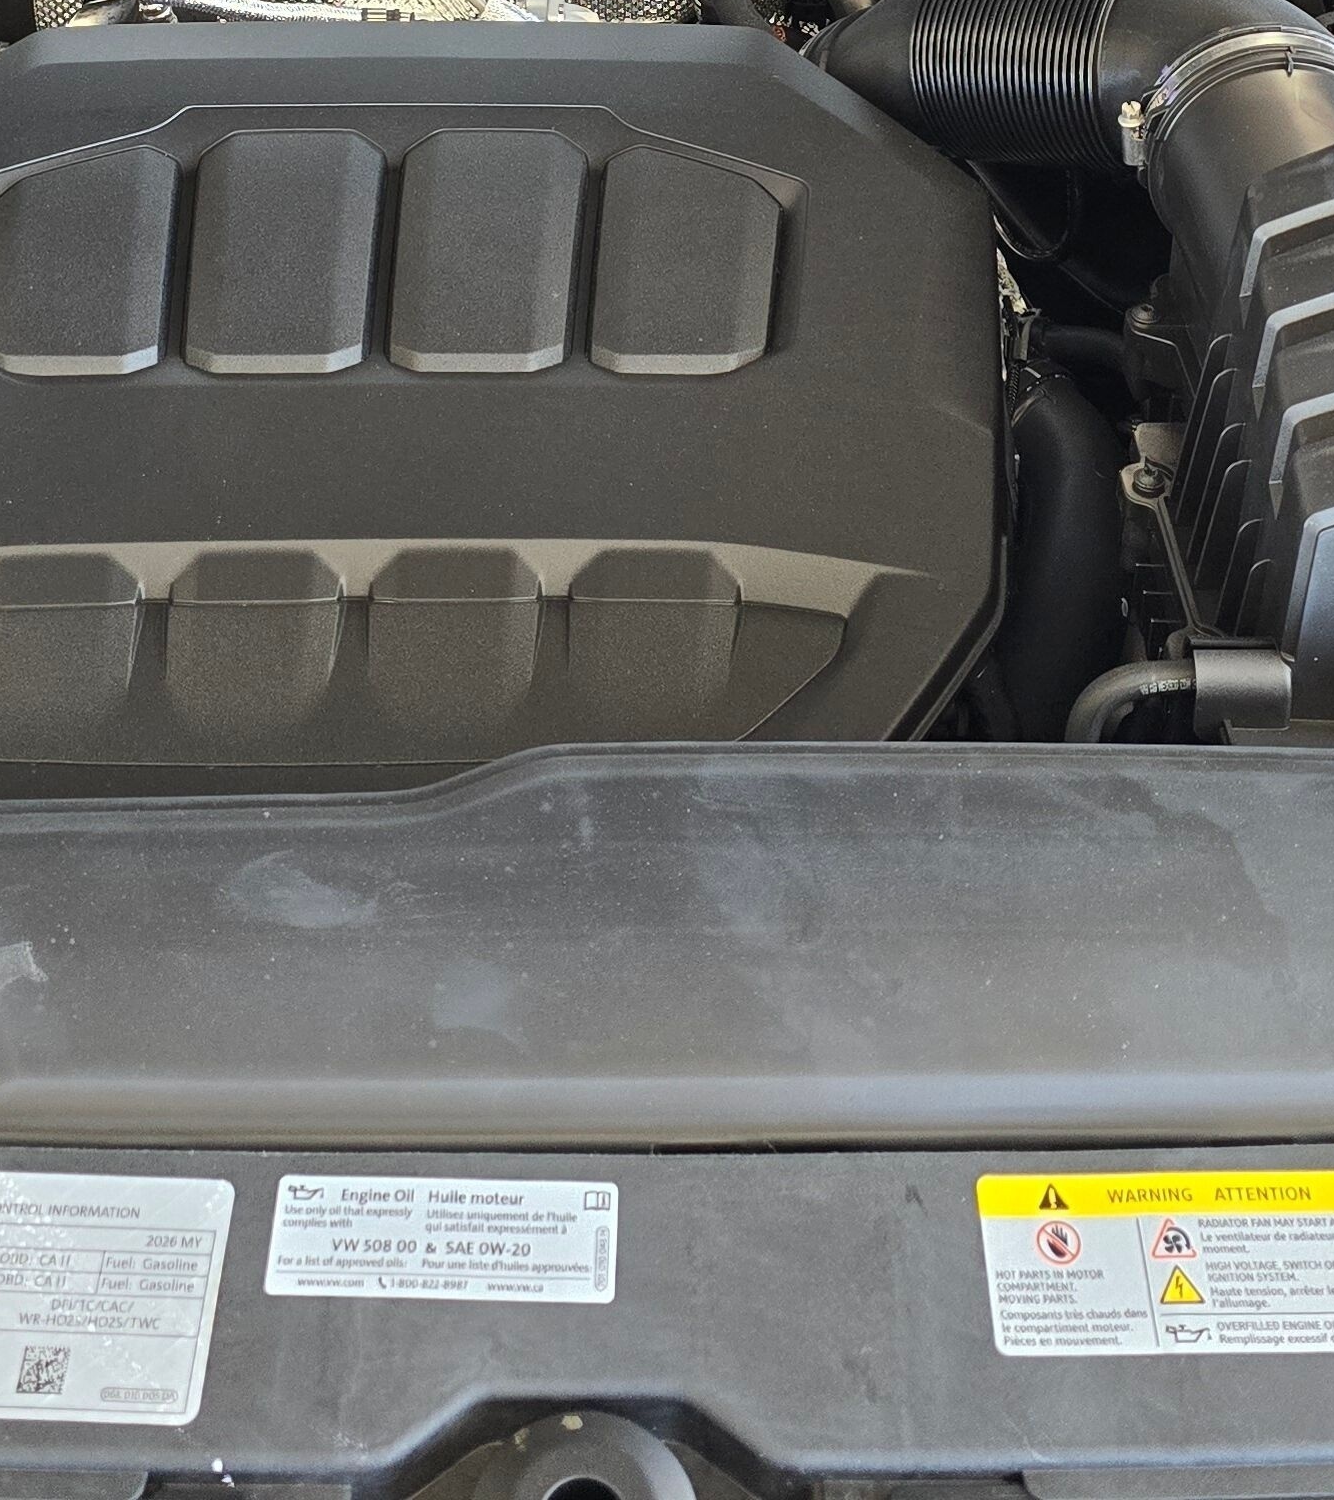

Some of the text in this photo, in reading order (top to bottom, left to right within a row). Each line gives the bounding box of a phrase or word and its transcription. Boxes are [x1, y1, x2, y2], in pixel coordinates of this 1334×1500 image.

[341, 1189, 414, 1205] Engine Oil
[428, 1190, 524, 1206] Huile moteur
[1107, 1186, 1311, 1204] WARNING ATTENTION
[48, 1204, 141, 1219] INFORMATION
[285, 1205, 413, 1219] Use only oil that expressly
[427, 1209, 578, 1222] Utilisez uniquement de l'huile
[282, 1218, 353, 1229] complies with
[425, 1222, 442, 1233] qui
[444, 1222, 484, 1232] satisfait
[1198, 1218, 1248, 1228] RADIATOR
[1251, 1218, 1271, 1227] FAN
[1273, 1217, 1296, 1227] MAY
[1297, 1217, 1327, 1227] START
[146, 1235, 177, 1247] 2026
[181, 1236, 203, 1248] MY
[1200, 1232, 1212, 1242] Le
[1215, 1231, 1270, 1242] ventilateur
[1274, 1230, 1287, 1241] de
[1289, 1230, 1334, 1241] radiateur
[332, 1238, 531, 1257] VW 508 00 & SAE 0W-20
[39, 1254, 58, 1266] CA
[106, 1257, 136, 1270] Fuel:
[142, 1258, 198, 1272] Gasoline
[278, 1255, 294, 1265] For
[305, 1255, 320, 1266] list
[322, 1256, 334, 1266] of
[336, 1257, 384, 1268] approved
[422, 1260, 445, 1270] Pour
[448, 1261, 465, 1270] une
[469, 1259, 489, 1270] liste
[1206, 1261, 1230, 1272] HIGH
[1284, 1259, 1322, 1271] SWITCH
[995, 1269, 1104, 1280] HOT PARTS IN MOTOR
[1208, 1272, 1254, 1283] IGNITION
[34, 1274, 53, 1287] CA
[101, 1278, 132, 1290] Fuel:
[139, 1279, 195, 1291] Gasoline
[1210, 1287, 1243, 1297] Haute
[999, 1294, 1041, 1305] MOVING
[1000, 1308, 1148, 1322] Composants très chauds dans
[1002, 1322, 1011, 1333] le
[1014, 1322, 1089, 1335] compartiment
[1217, 1320, 1280, 1332] OVERFILLED
[1282, 1319, 1322, 1331] ENGINE
[1004, 1334, 1037, 1346] Pièces
[1040, 1336, 1052, 1346] en
[1219, 1333, 1285, 1345] Remplissage
[1288, 1332, 1328, 1344] excessif
